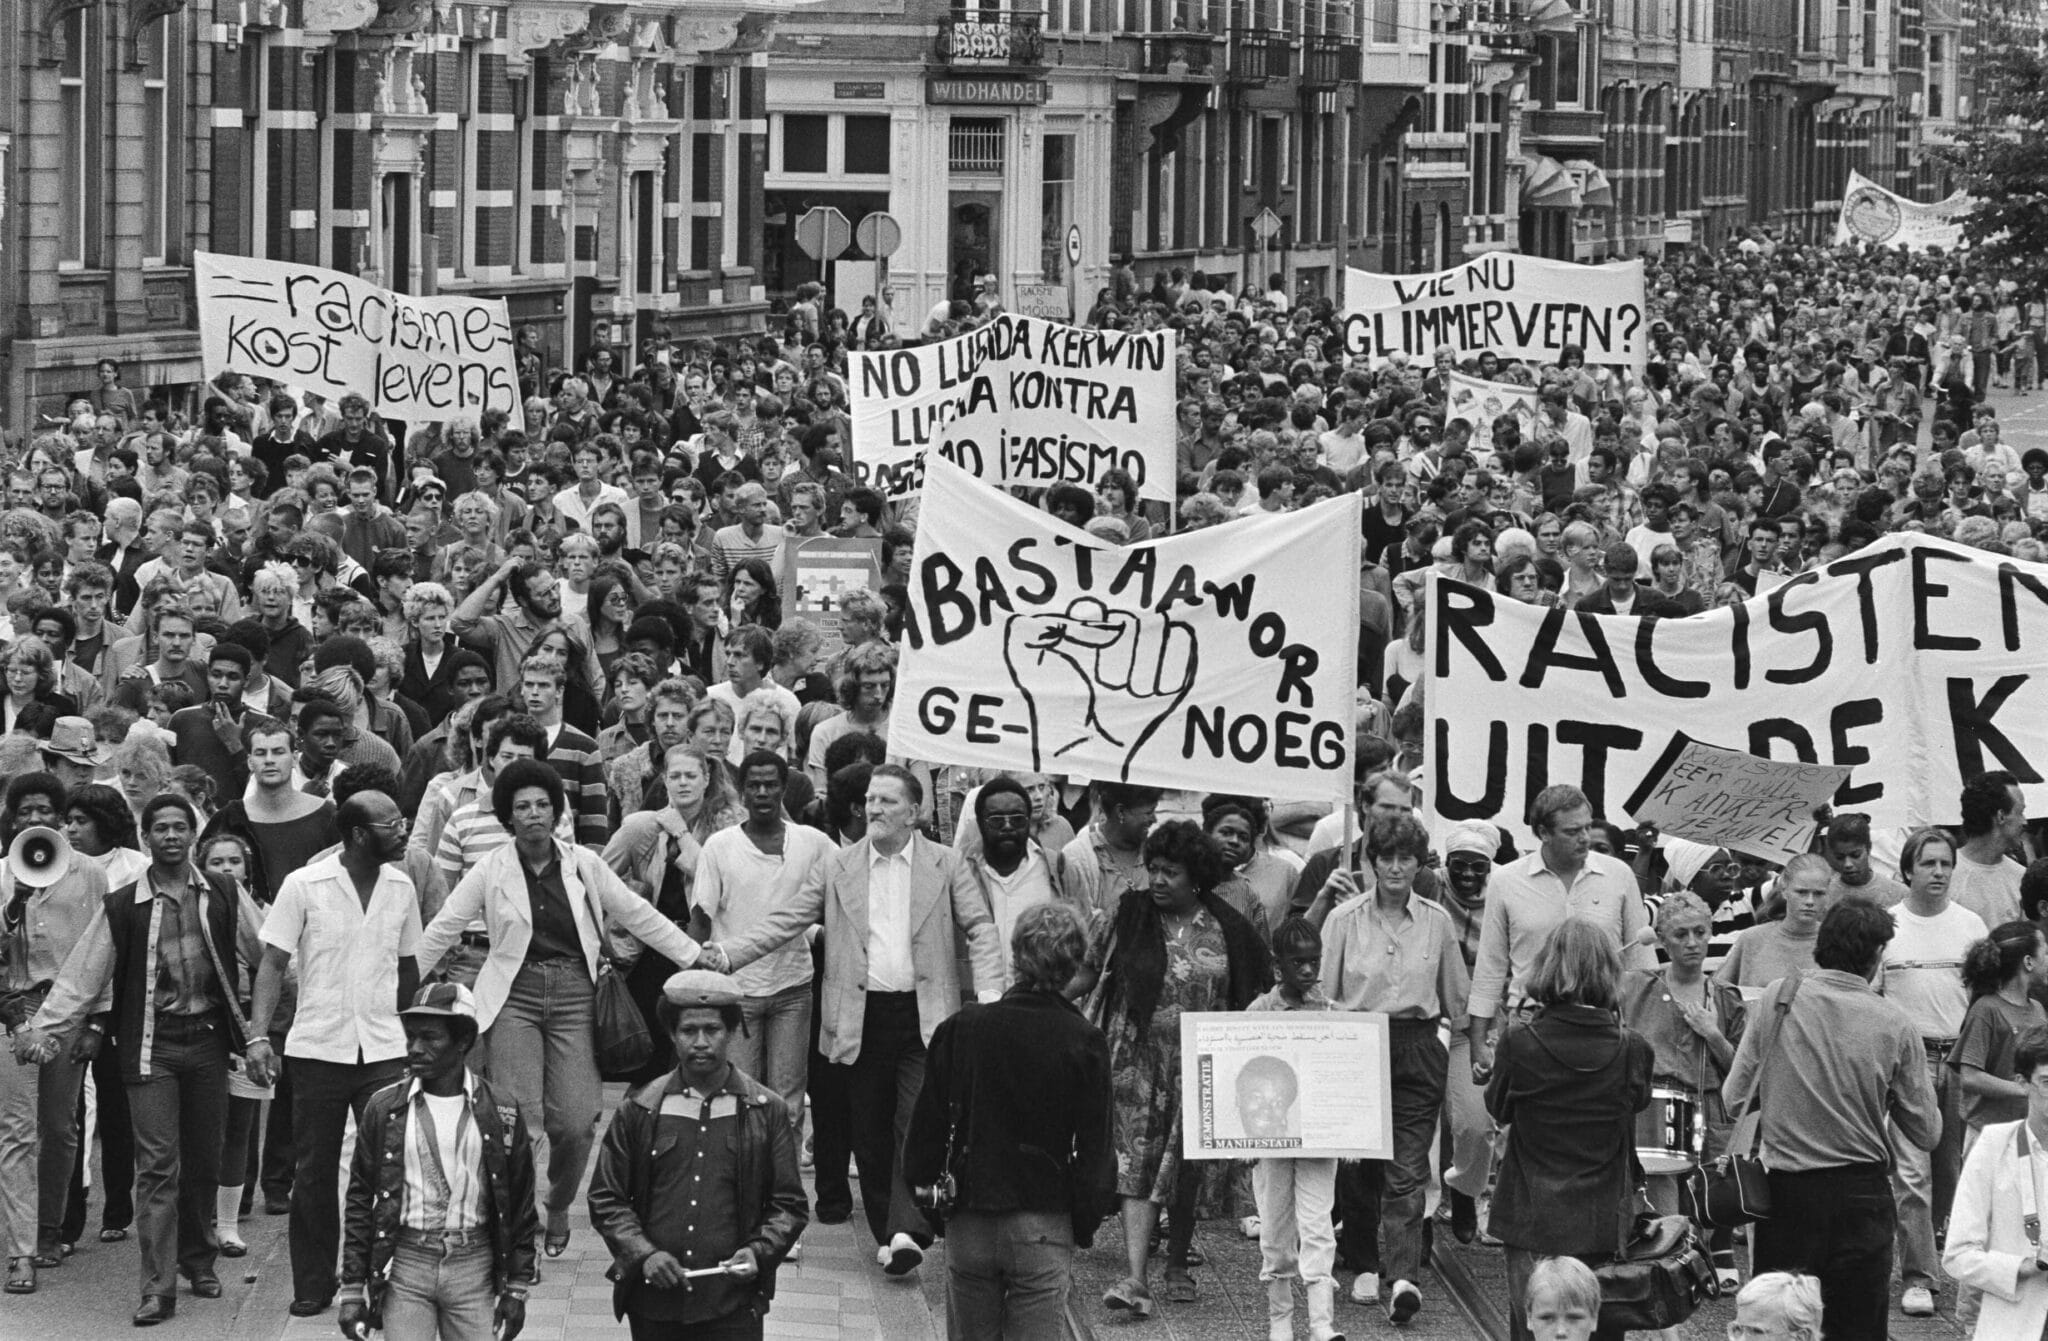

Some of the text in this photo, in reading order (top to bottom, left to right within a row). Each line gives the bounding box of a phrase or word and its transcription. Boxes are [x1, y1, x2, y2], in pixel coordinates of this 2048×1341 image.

[934, 82, 1043, 100] WILDHANDEL
[1467, 258, 1515, 292] NU
[862, 351, 921, 399] NO
[1009, 371, 1138, 423] KONTRA
[1182, 705, 1346, 770] NOEG
[1435, 718, 1643, 825] UIT
[1202, 1059, 1212, 1149] DEMONSTRATIE
[1215, 1138, 1300, 1149] MANIFESTATIE
